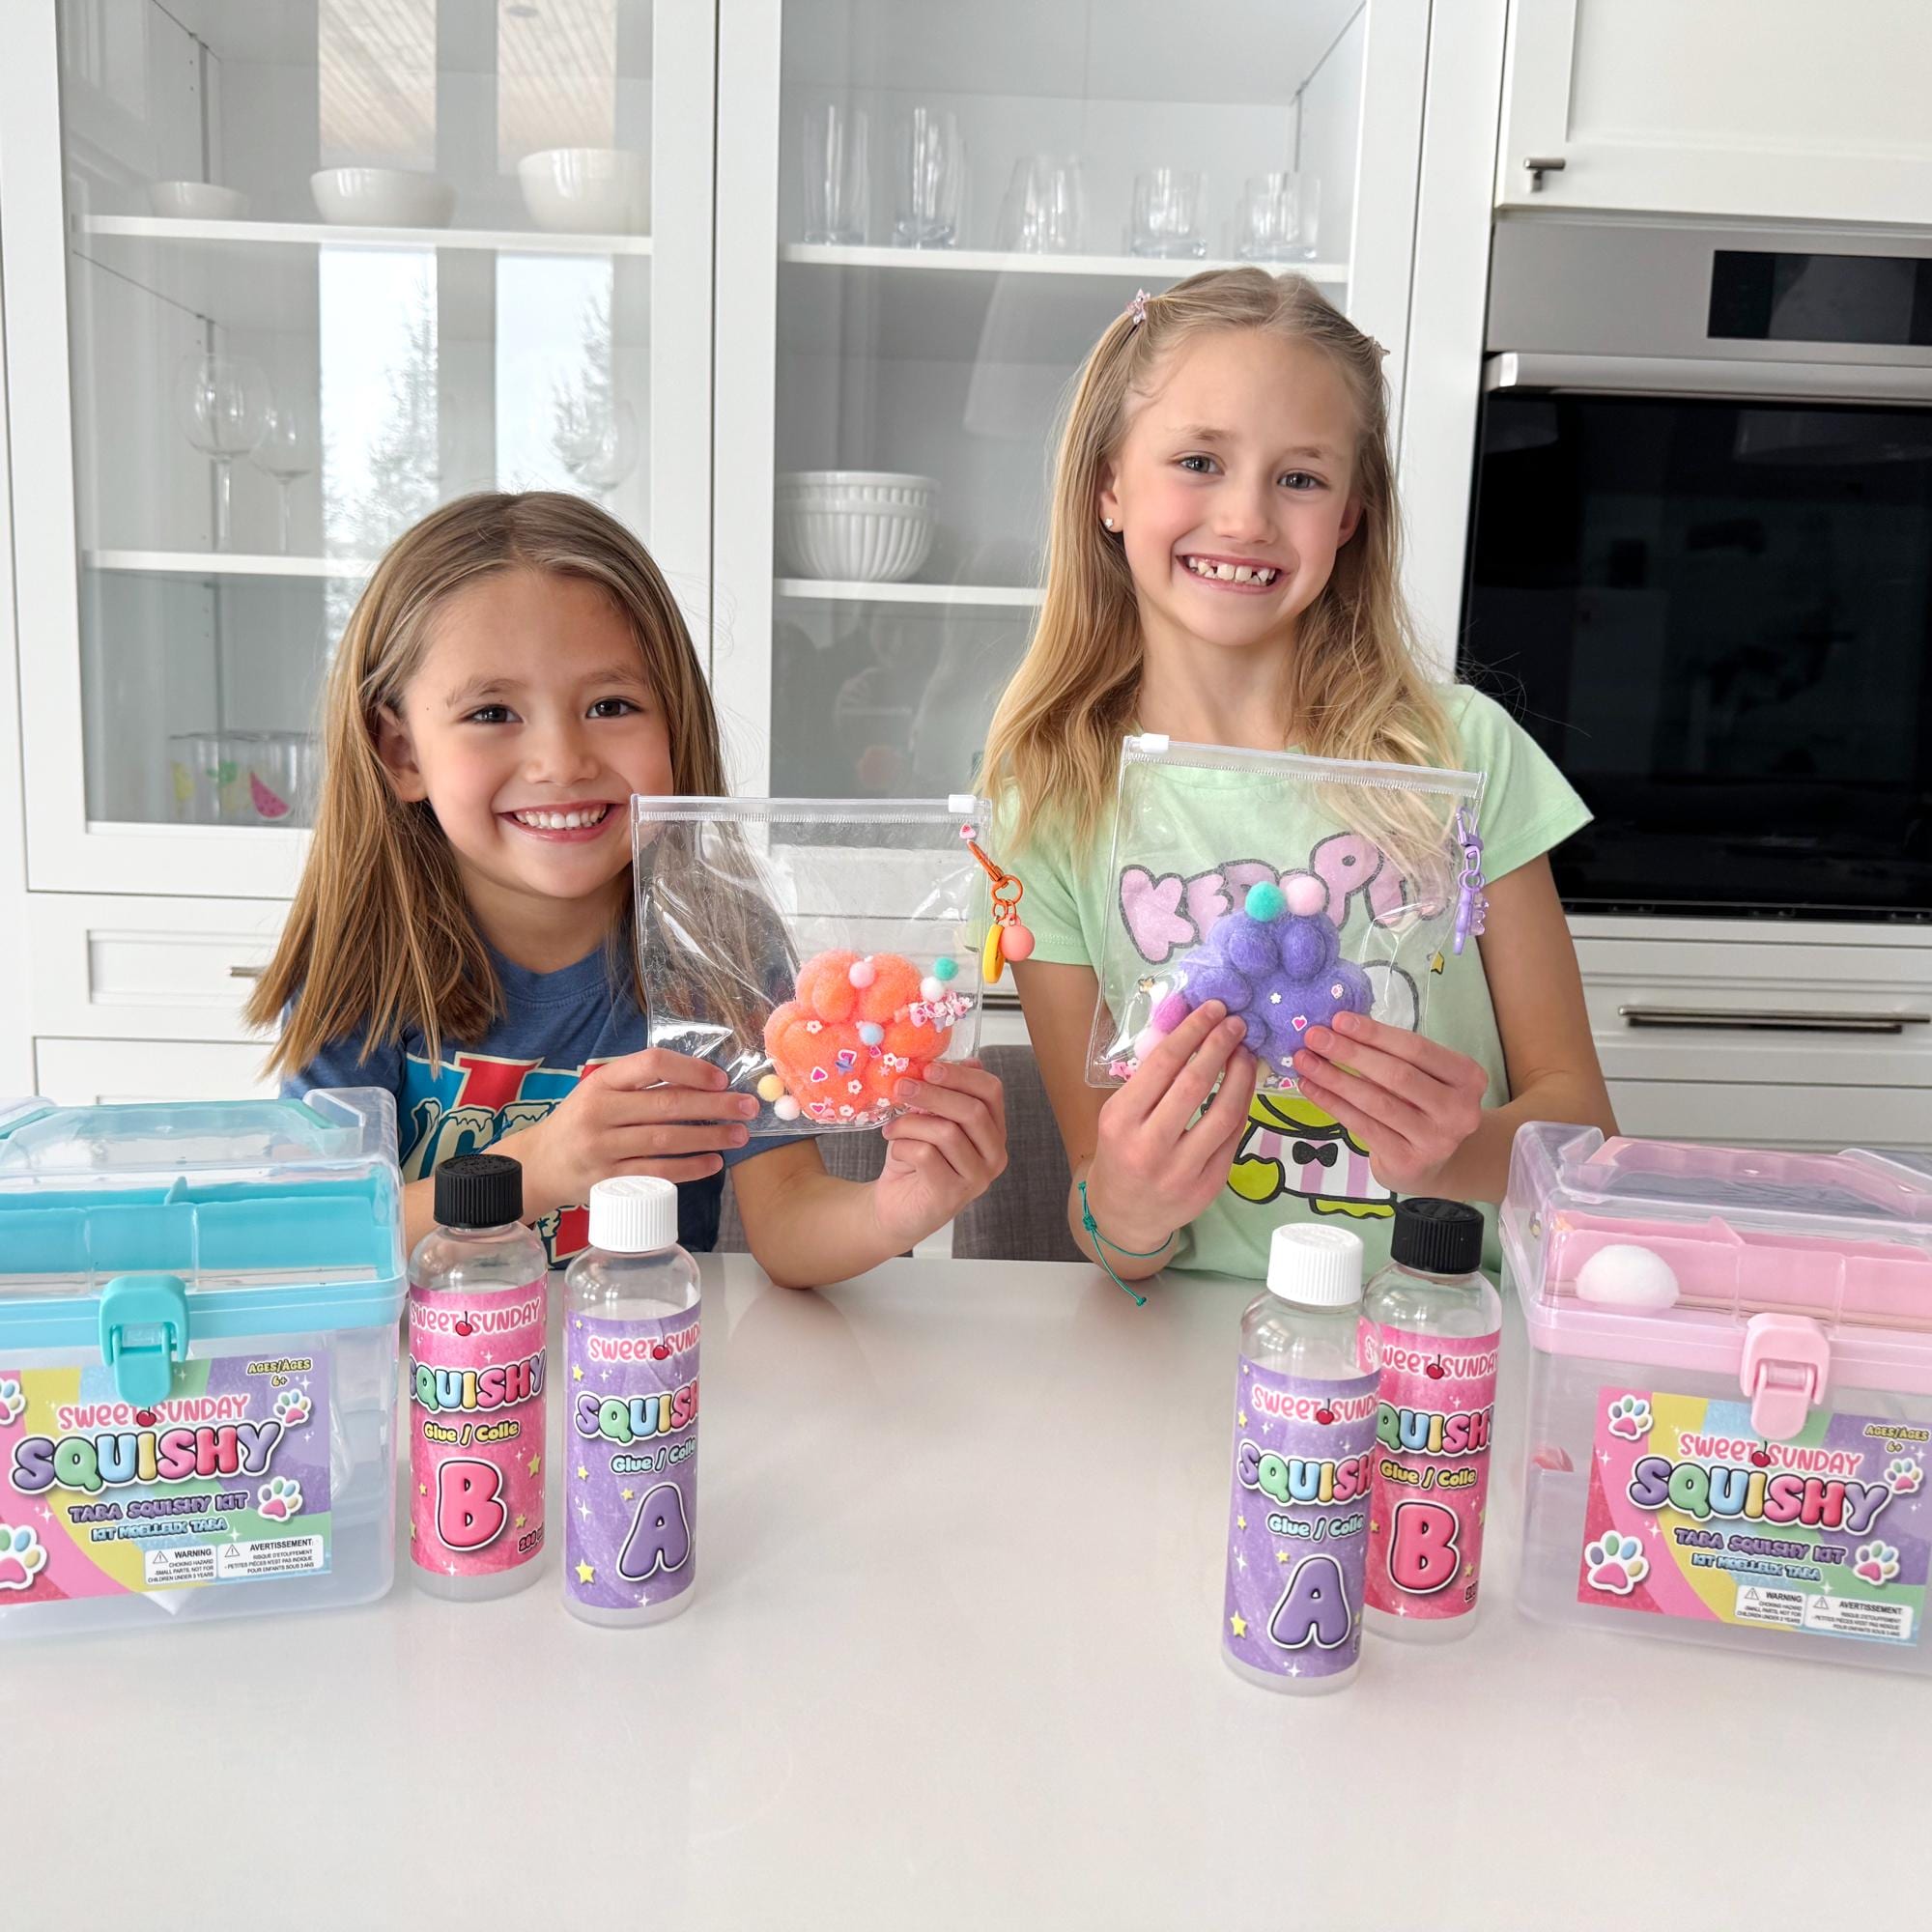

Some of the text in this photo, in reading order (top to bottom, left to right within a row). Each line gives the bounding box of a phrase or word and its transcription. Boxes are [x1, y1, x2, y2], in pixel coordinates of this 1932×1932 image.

[469, 1297, 541, 1333] SUNDAY
[665, 1322, 700, 1355] SUND
[270, 1375, 288, 1387] 6+
[156, 1396, 248, 1424] SUNDAY
[576, 1380, 699, 1443] SQUIS
[1332, 1394, 1377, 1423] SUND
[424, 1419, 520, 1446] Glue / Colle
[1376, 1402, 1493, 1453] QUISH
[13, 1421, 281, 1492] SQUISHY
[611, 1454, 653, 1473] Glue
[655, 1447, 667, 1471] /
[1237, 1441, 1375, 1503] SQUISH
[1767, 1443, 1864, 1476] SUNDAY
[1379, 1460, 1477, 1490] Glue / Colle
[69, 1492, 248, 1523] TABA SQUISHY KIT
[438, 1459, 506, 1549] B
[1629, 1457, 1890, 1533] SQUISHY
[91, 1518, 227, 1542] KIT MOELLEUX TABA
[618, 1482, 690, 1580] A
[1267, 1513, 1311, 1538] Glue
[1312, 1518, 1326, 1541] /
[174, 1548, 212, 1559] WARNING
[249, 1538, 312, 1551] AVERTISSEMENT
[1388, 1501, 1459, 1592] B
[1674, 1528, 1847, 1565] TABA SQUISHY KIT
[1691, 1553, 1715, 1566] KIT
[1785, 1565, 1821, 1581] TABA
[1268, 1554, 1350, 1648] A
[1766, 1592, 1803, 1603] WARNING
